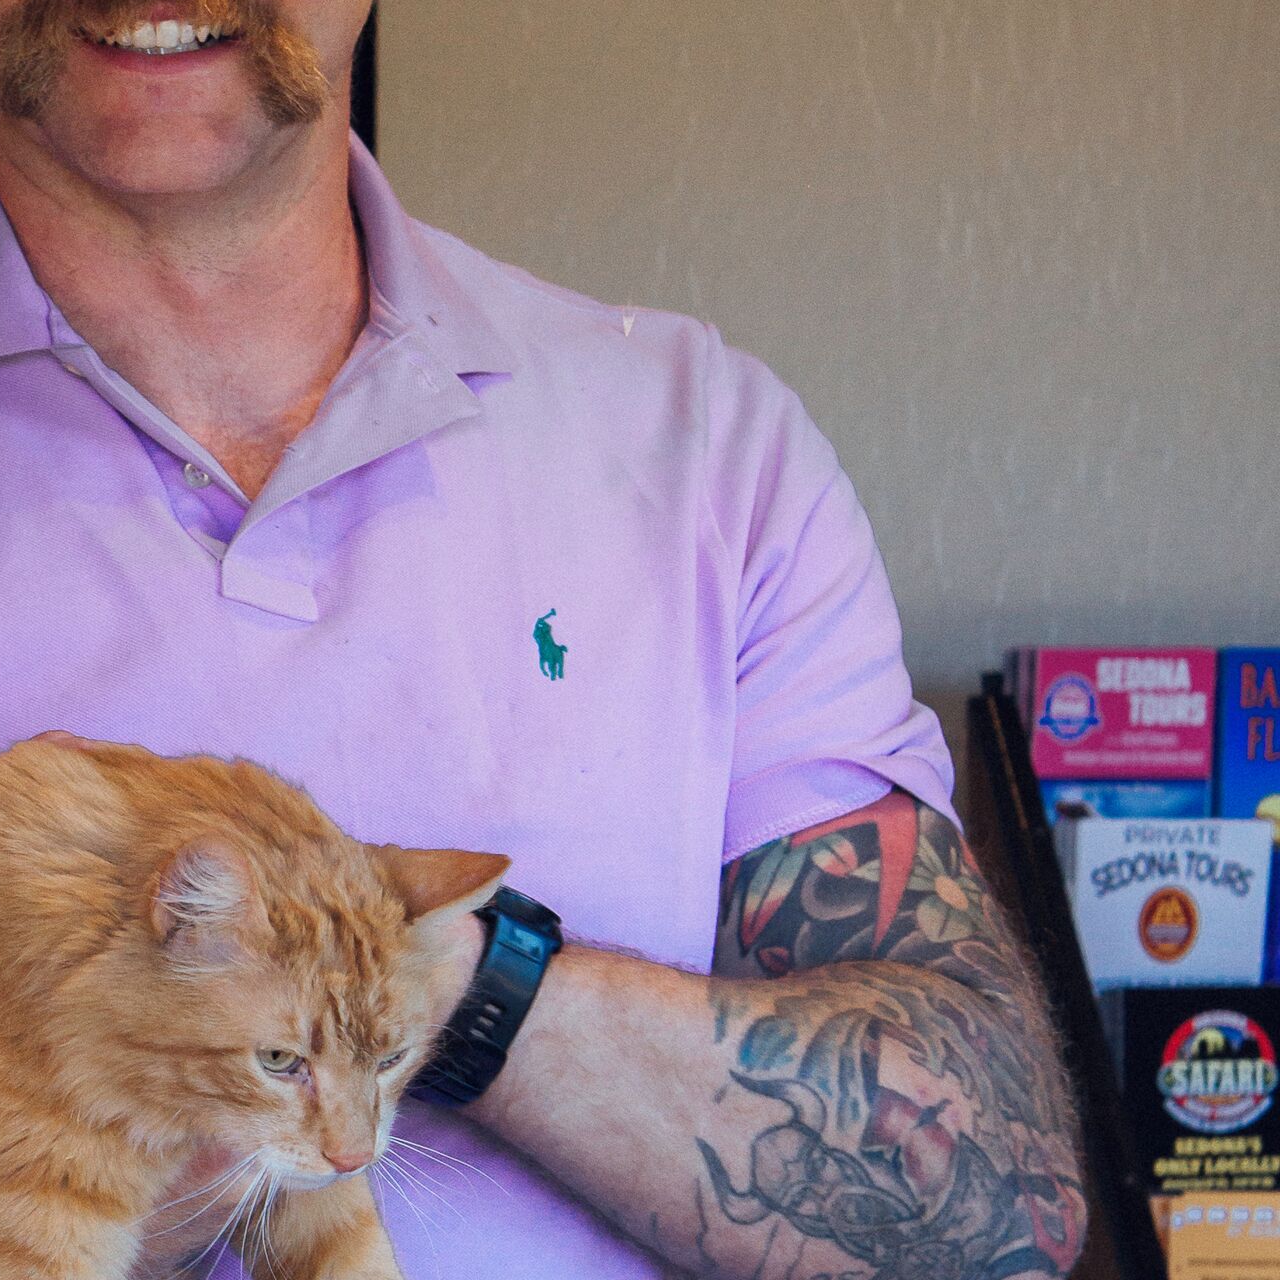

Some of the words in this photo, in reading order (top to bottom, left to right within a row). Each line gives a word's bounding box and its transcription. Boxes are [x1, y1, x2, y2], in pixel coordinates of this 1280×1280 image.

[1124, 825, 1220, 844] PRIVATE
[1090, 850, 1179, 898] SEDONA
[1183, 850, 1255, 898] TOURS
[1171, 1058, 1265, 1097] SAFARI
